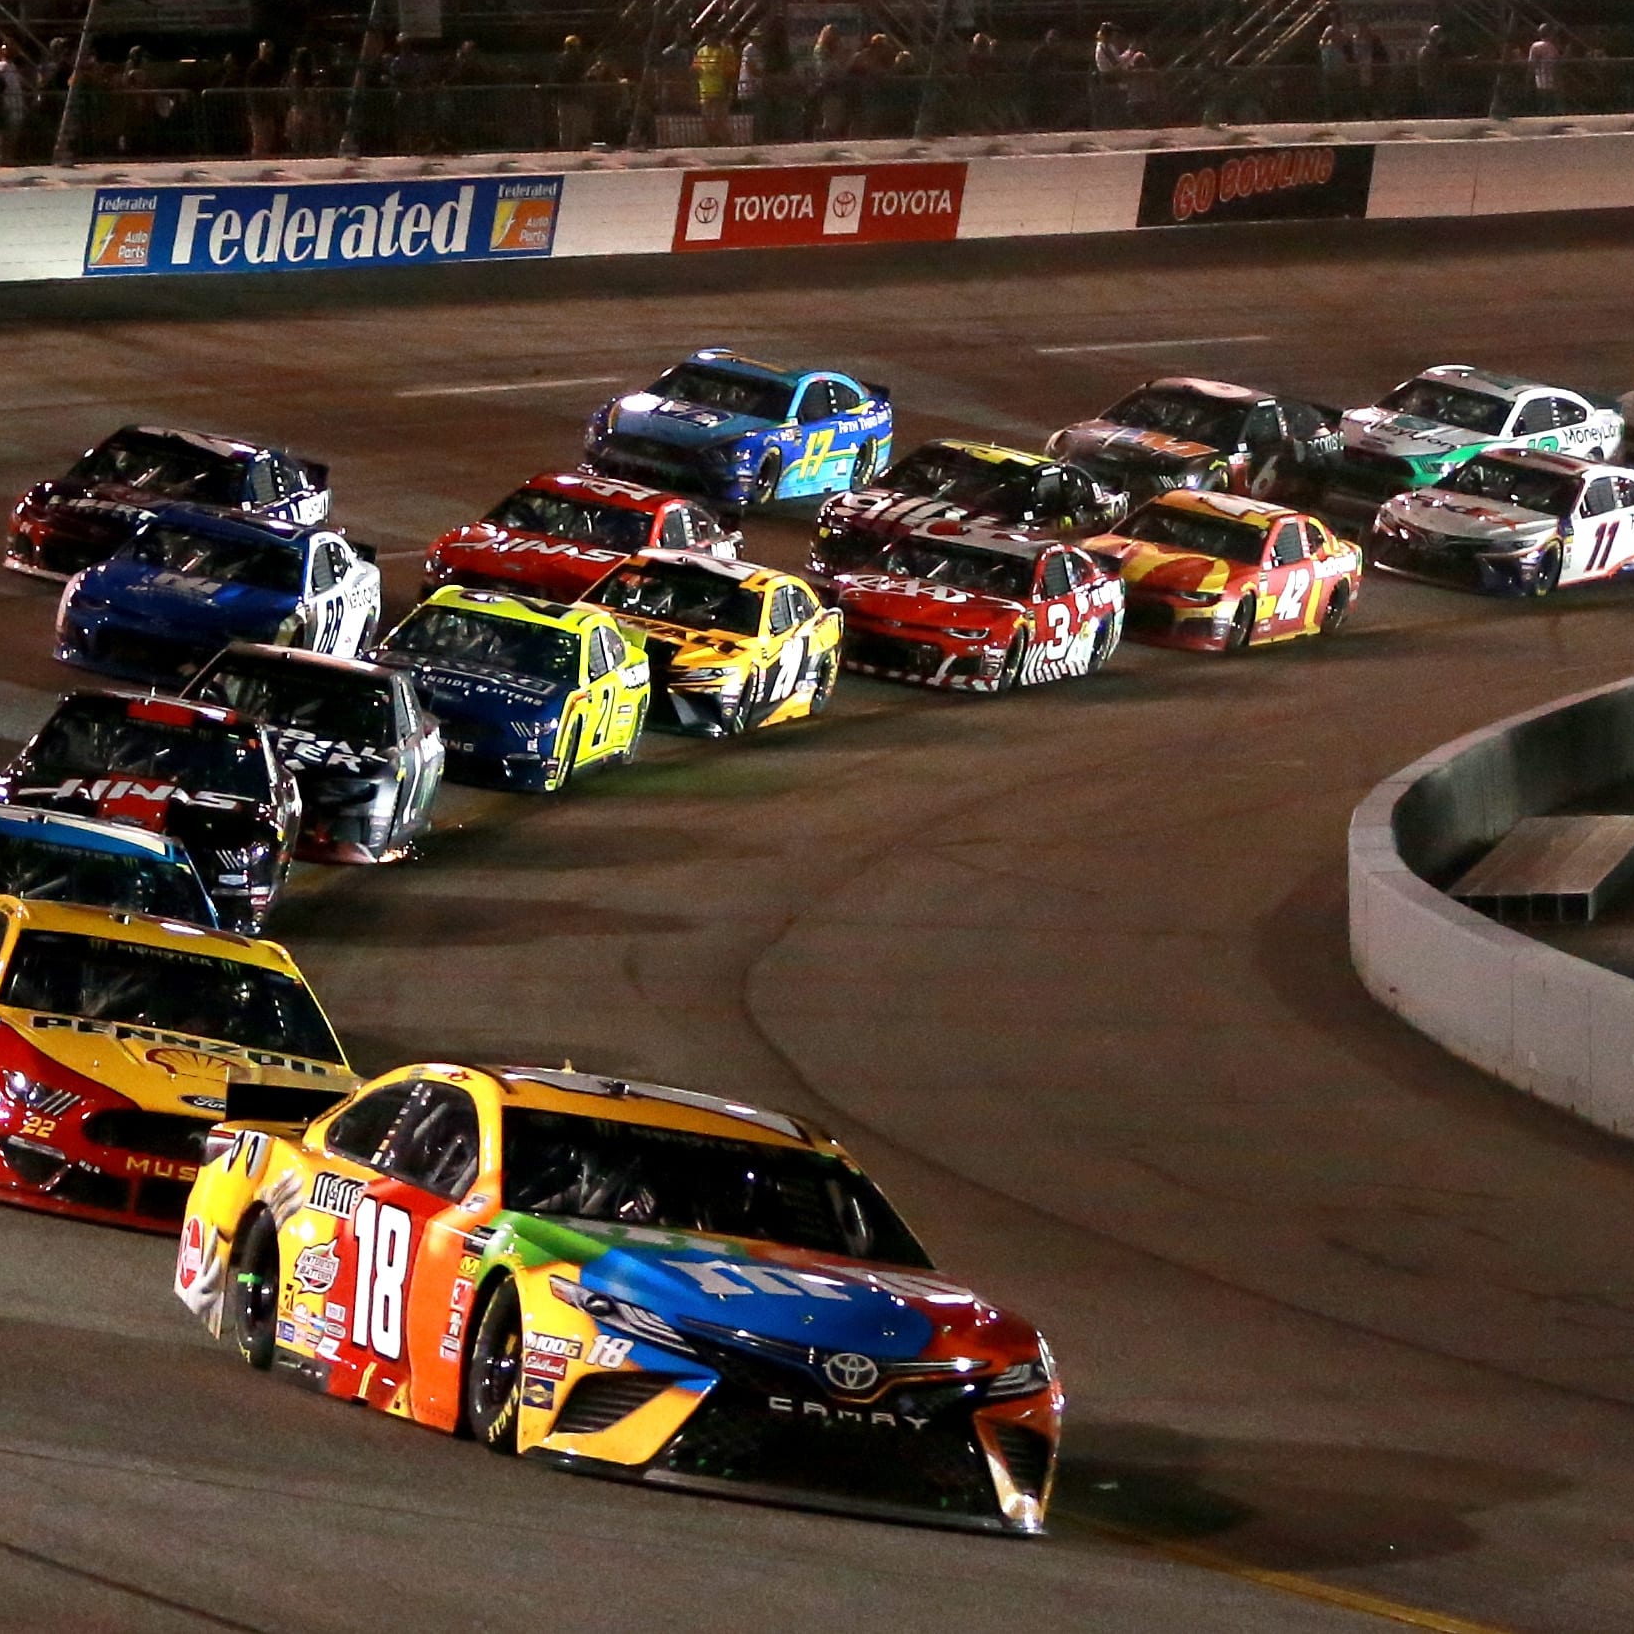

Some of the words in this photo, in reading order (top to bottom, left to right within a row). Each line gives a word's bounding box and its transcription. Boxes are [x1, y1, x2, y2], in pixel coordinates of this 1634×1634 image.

[497, 181, 558, 198] Federated
[869, 188, 953, 216] TOYOTA
[1173, 167, 1216, 221] GO
[1219, 148, 1335, 202] BOWLING
[97, 194, 159, 212] Federated
[732, 193, 816, 223] TOYOTA
[124, 230, 149, 245] Auto
[170, 184, 476, 266] Federated
[117, 244, 146, 259] Parts
[797, 427, 836, 482] 17
[1583, 519, 1620, 571] 11
[1274, 567, 1311, 622] 42
[1047, 602, 1071, 661] 3
[591, 685, 616, 747] 21
[22, 1115, 57, 1139] 22
[351, 1193, 412, 1362] 18
[585, 1334, 635, 1369] 18
[768, 1395, 930, 1431] CAMRY
